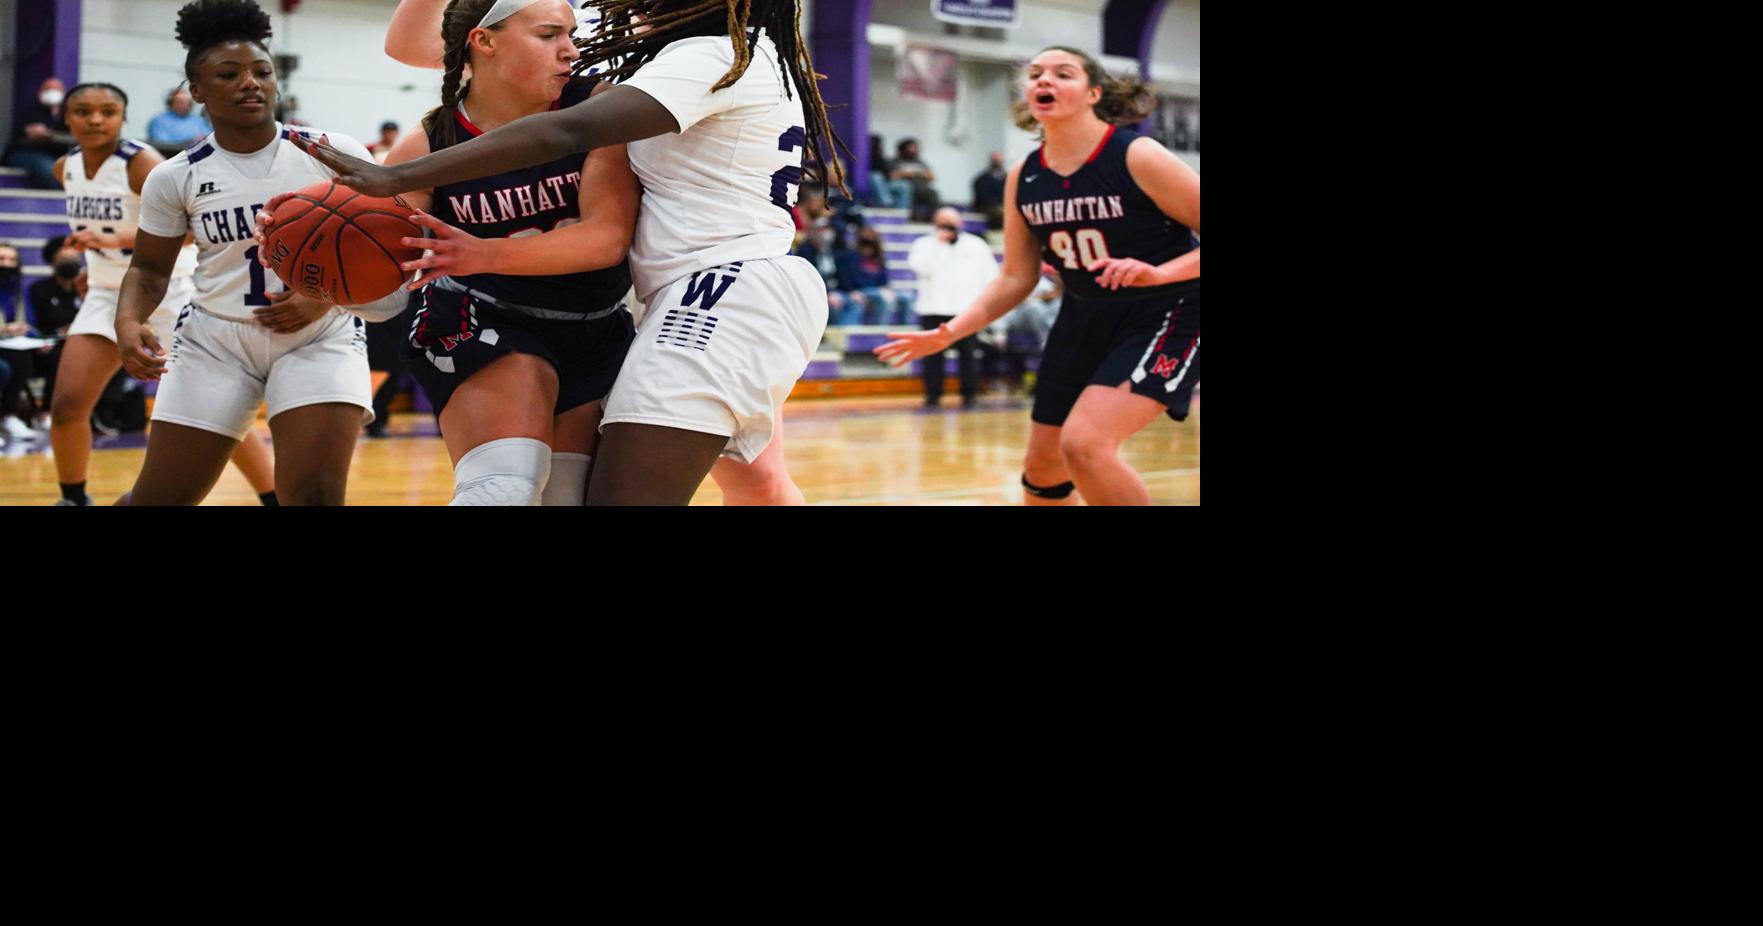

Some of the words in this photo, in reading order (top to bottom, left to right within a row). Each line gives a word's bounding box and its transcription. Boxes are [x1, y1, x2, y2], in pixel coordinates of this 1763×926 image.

[449, 171, 581, 224] MANHATT
[1021, 195, 1124, 225] MANHATTAN
[680, 272, 736, 311] W
